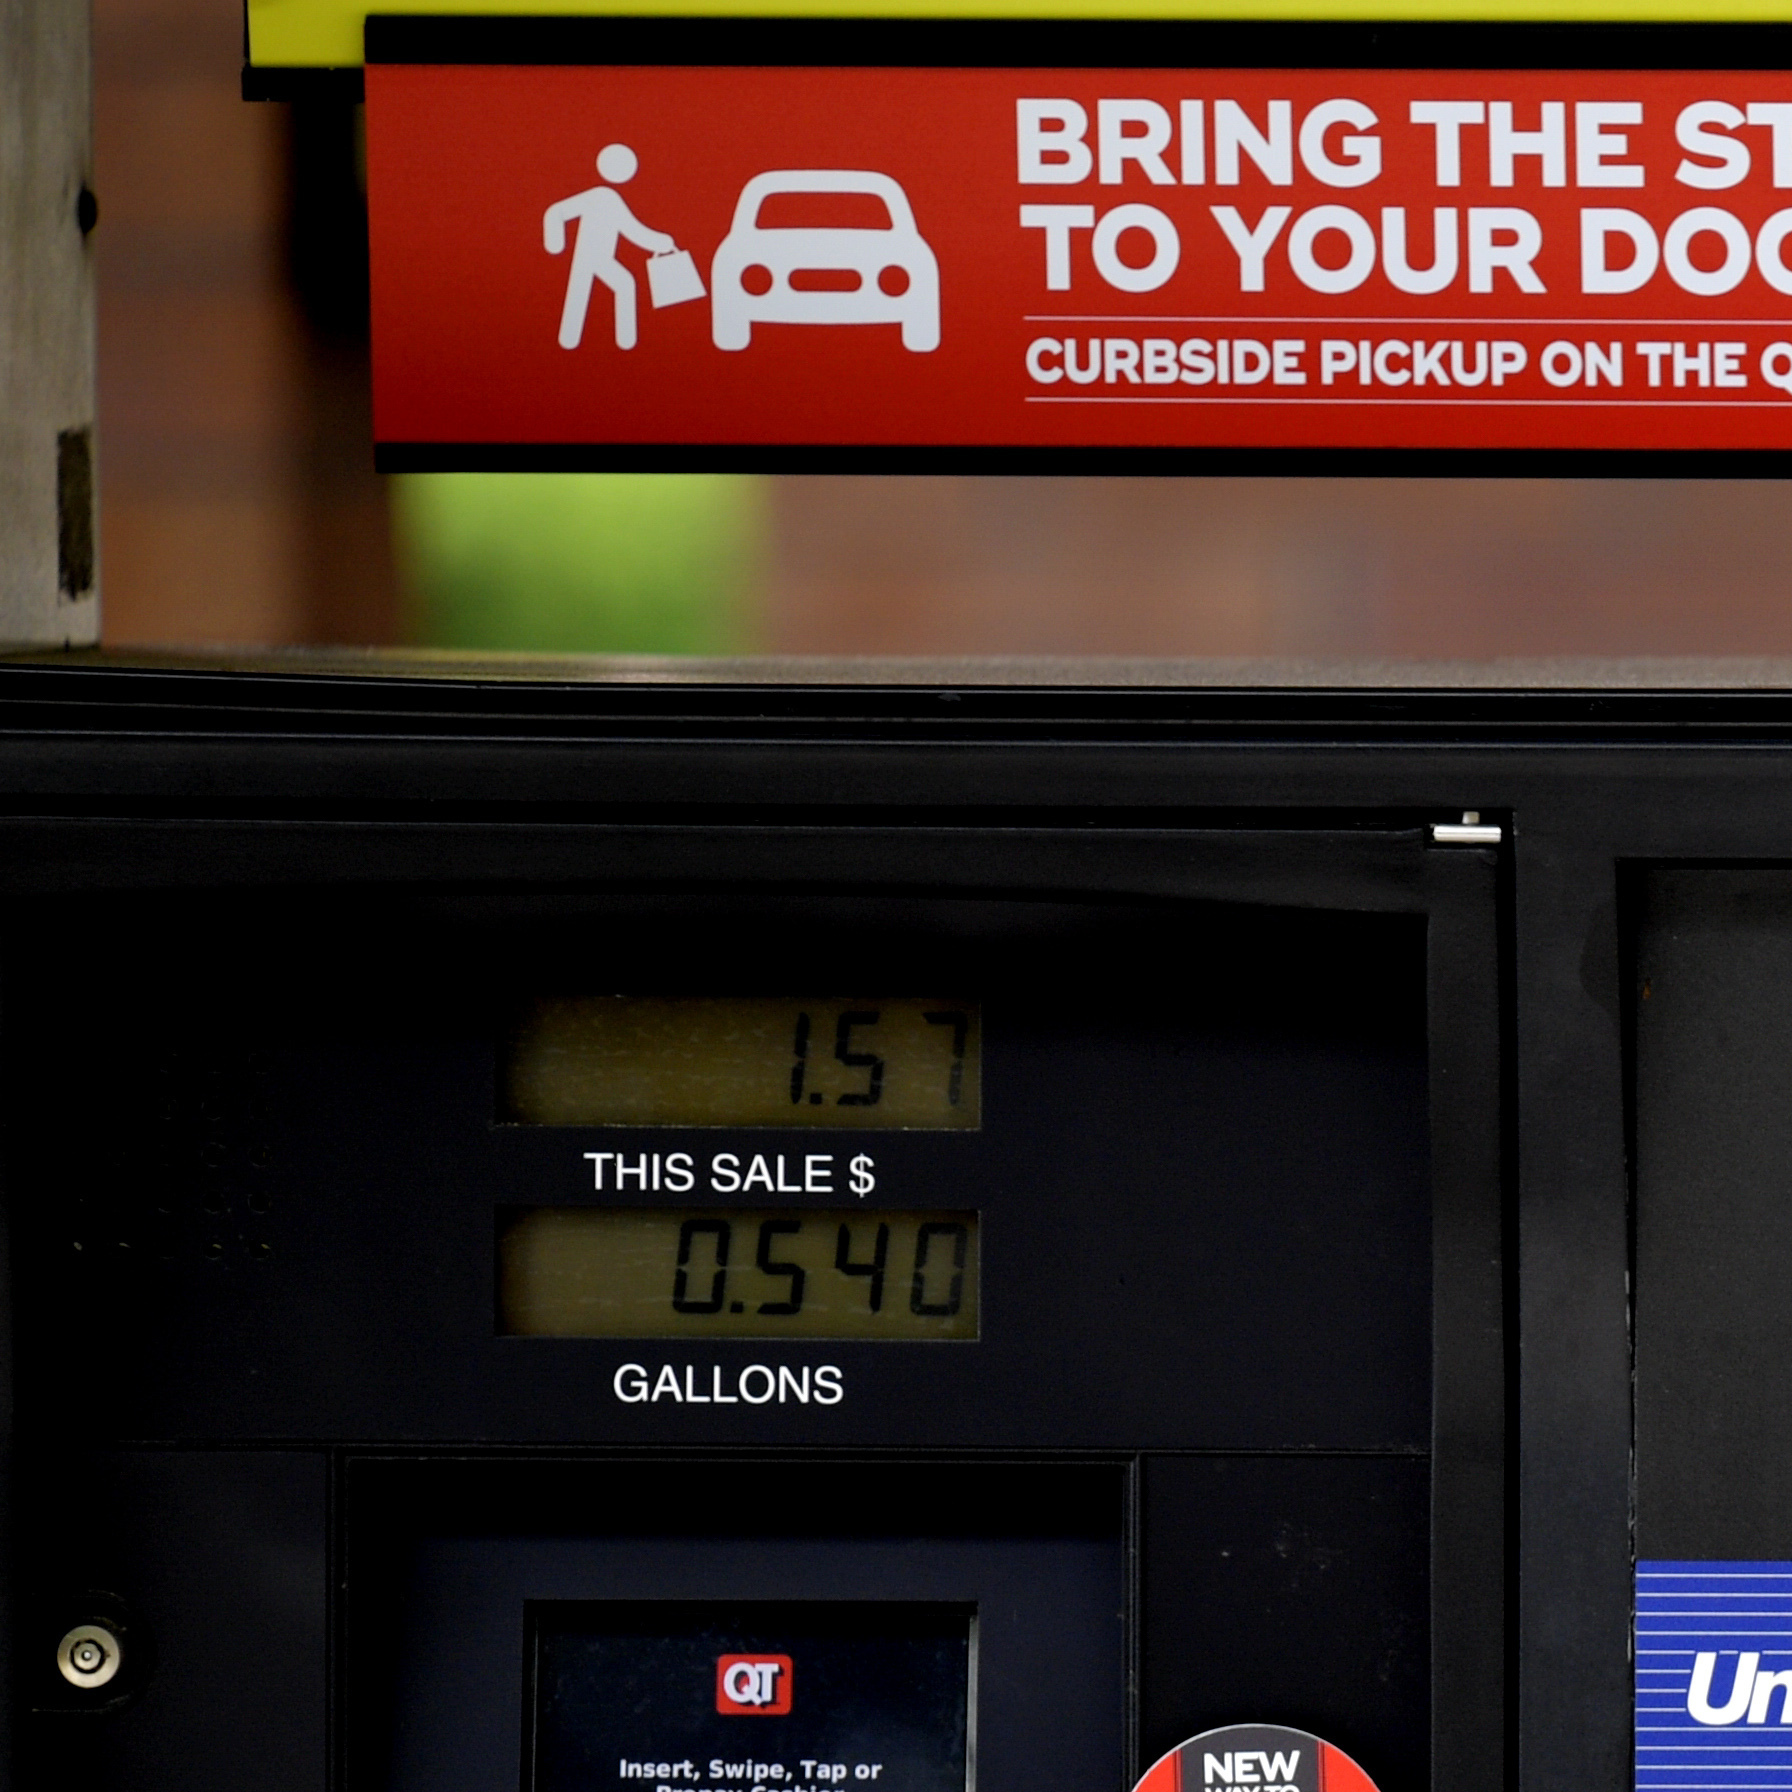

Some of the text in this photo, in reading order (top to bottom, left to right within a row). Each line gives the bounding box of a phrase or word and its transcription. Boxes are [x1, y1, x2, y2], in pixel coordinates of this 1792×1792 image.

[1017, 99, 1381, 187] BRING
[1410, 101, 1644, 187] THE
[1020, 204, 1180, 292] TO
[1210, 205, 1546, 294] YOUR
[1026, 338, 1306, 384] CURBSIDE
[1321, 340, 1527, 386] PICKUP
[1541, 341, 1622, 387] ON
[1636, 342, 1747, 387] THE
[790, 1010, 968, 1106] 1.57
[584, 1153, 875, 1197] THIS SALE $
[672, 1219, 968, 1315] 0.540
[614, 1364, 843, 1404] GALLONS
[723, 1662, 780, 1705] QT
[620, 1759, 882, 1783] Insert, Swipe, Tap or
[1203, 1750, 1300, 1784] NEW
